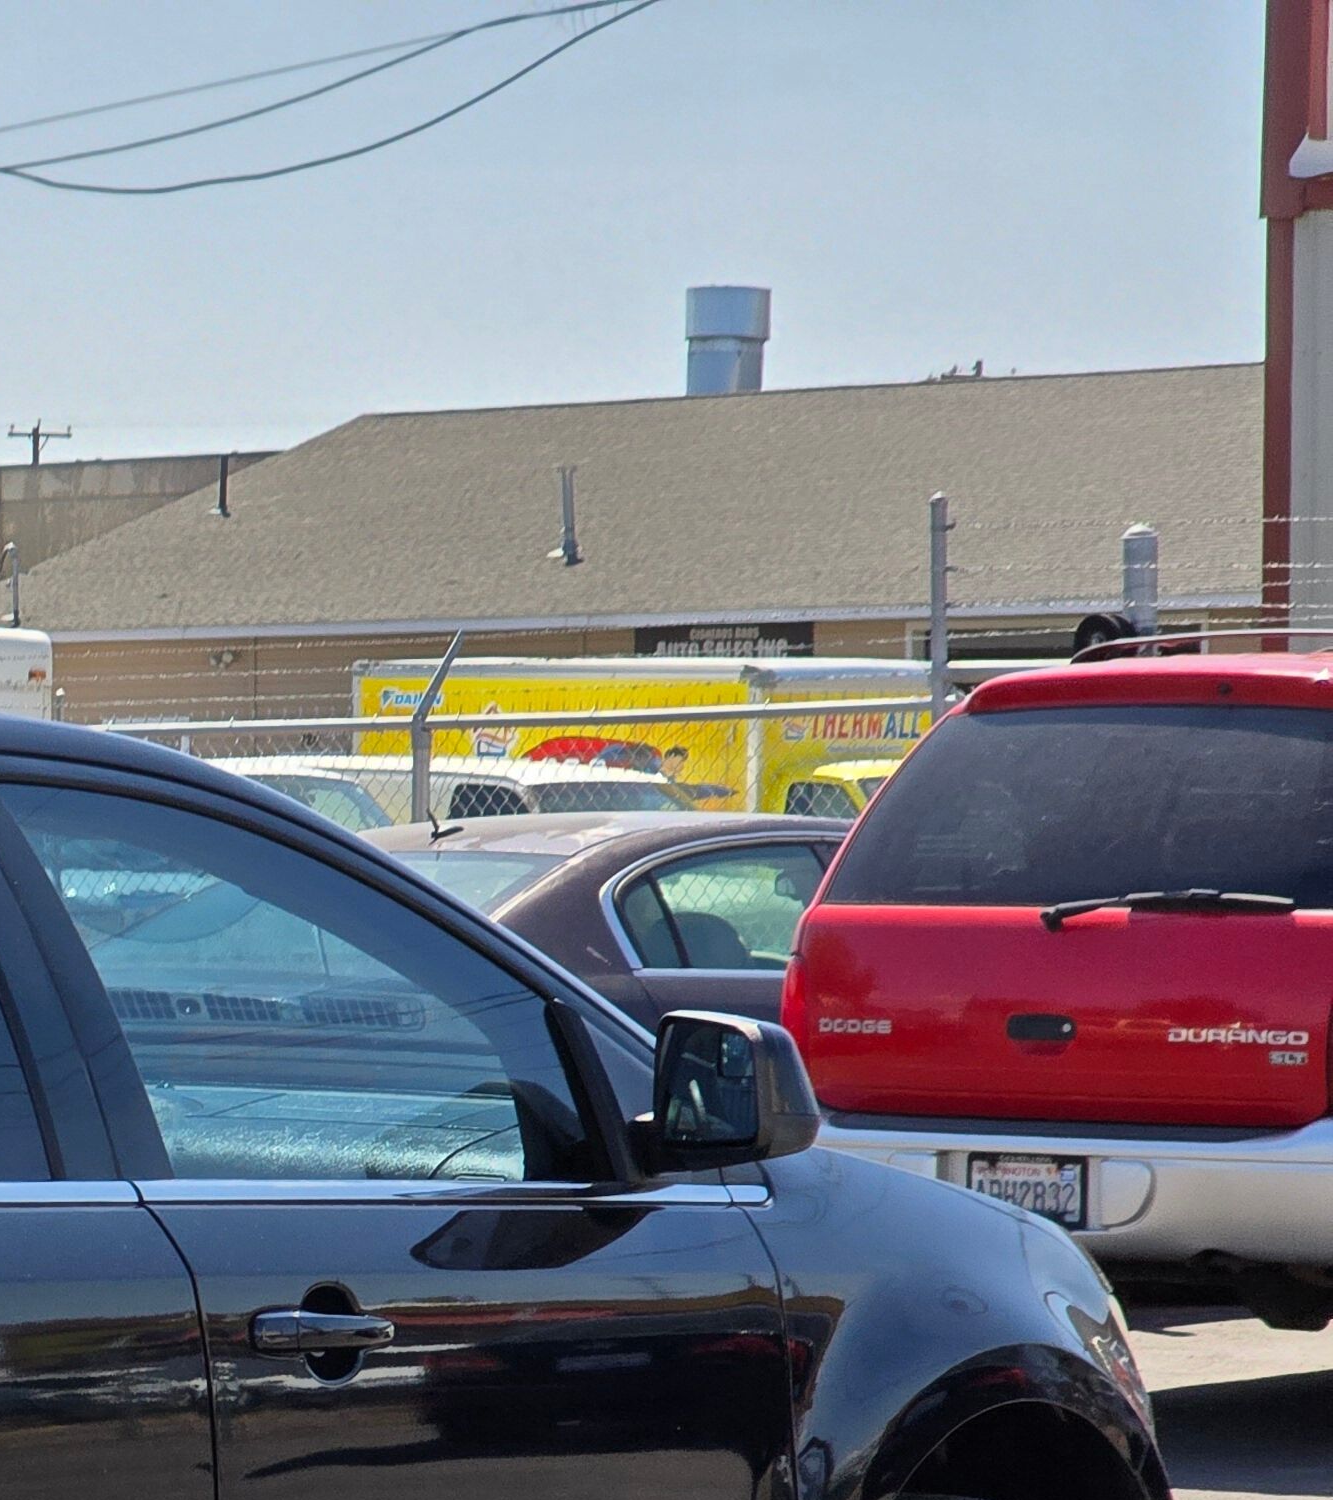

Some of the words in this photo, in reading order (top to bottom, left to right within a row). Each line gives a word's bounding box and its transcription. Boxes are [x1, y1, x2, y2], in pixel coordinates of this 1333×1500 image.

[395, 693, 443, 705] DAIN
[818, 1017, 892, 1034] DODGE
[1168, 1028, 1309, 1045] DURANGO
